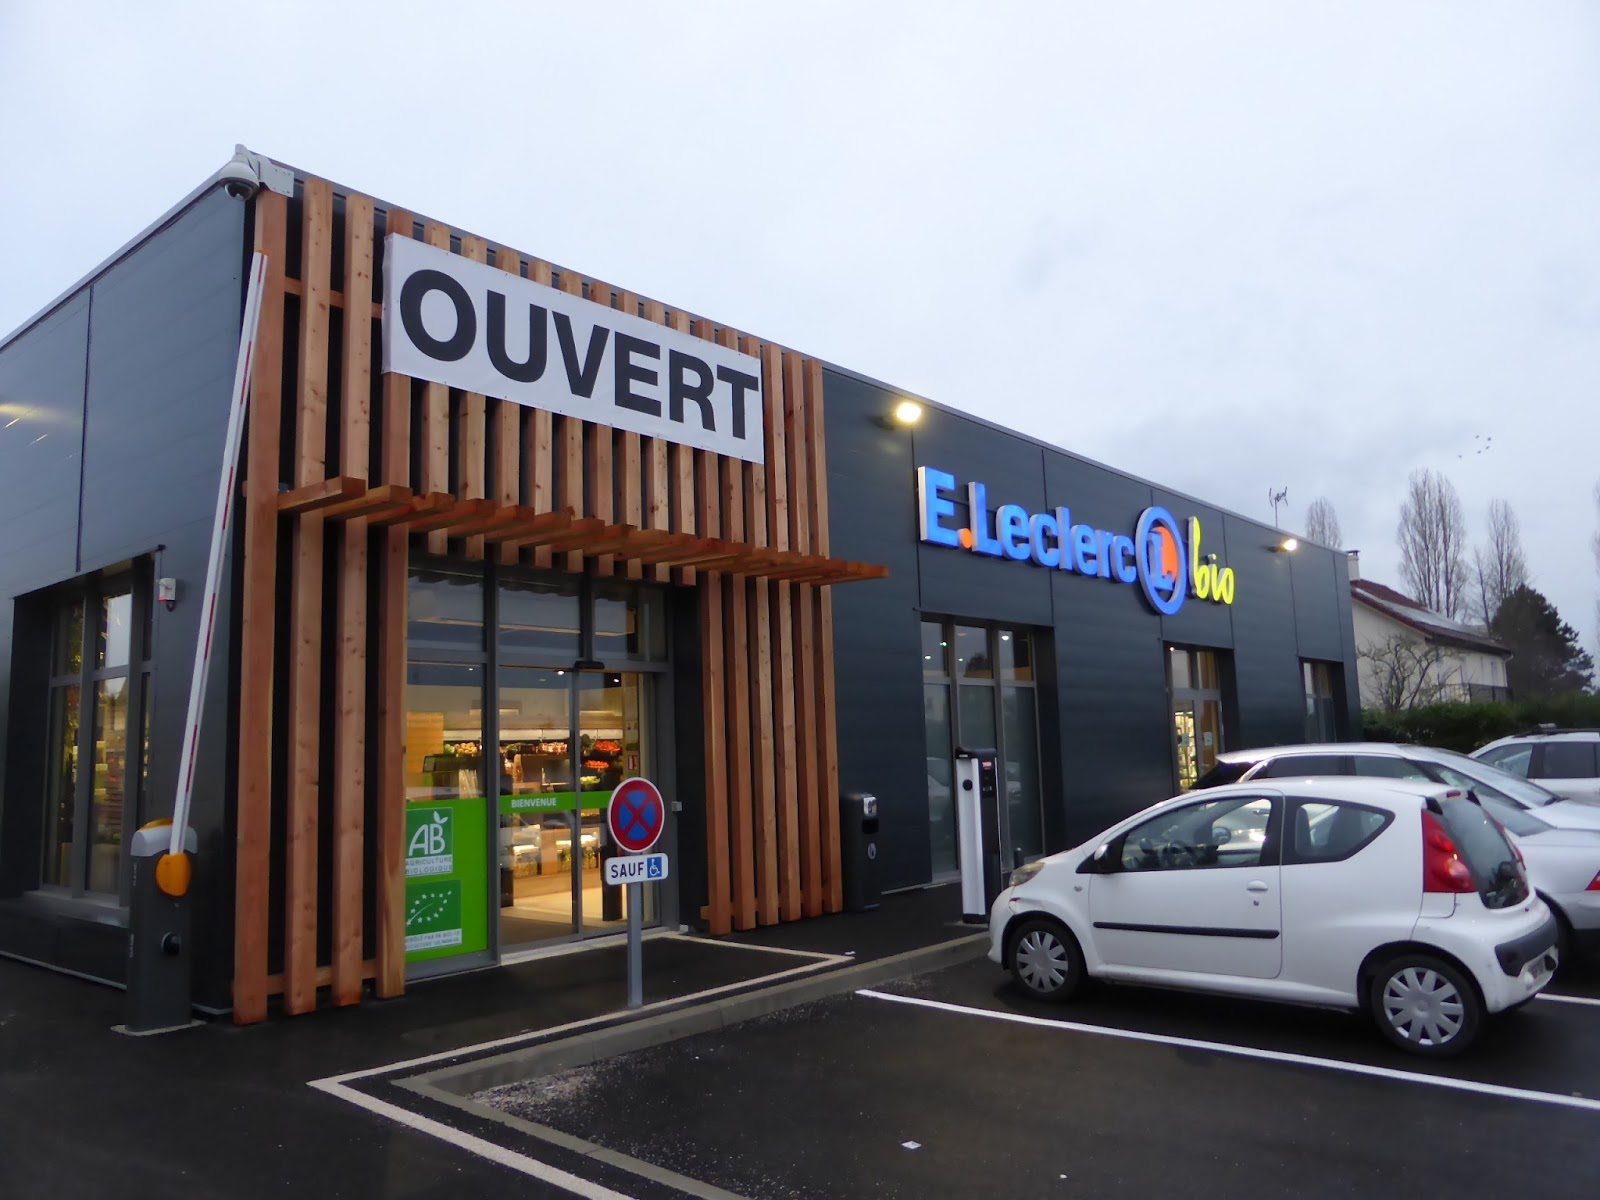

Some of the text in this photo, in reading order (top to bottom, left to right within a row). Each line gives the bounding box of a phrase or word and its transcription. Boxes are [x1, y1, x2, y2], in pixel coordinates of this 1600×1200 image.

[400, 269, 759, 440] OUVERT
[917, 466, 1136, 583] E.Leclerc
[1189, 516, 1234, 604] bio
[511, 797, 557, 808] BIENVENUE
[408, 823, 446, 856] AB
[611, 862, 644, 878] SAUF
